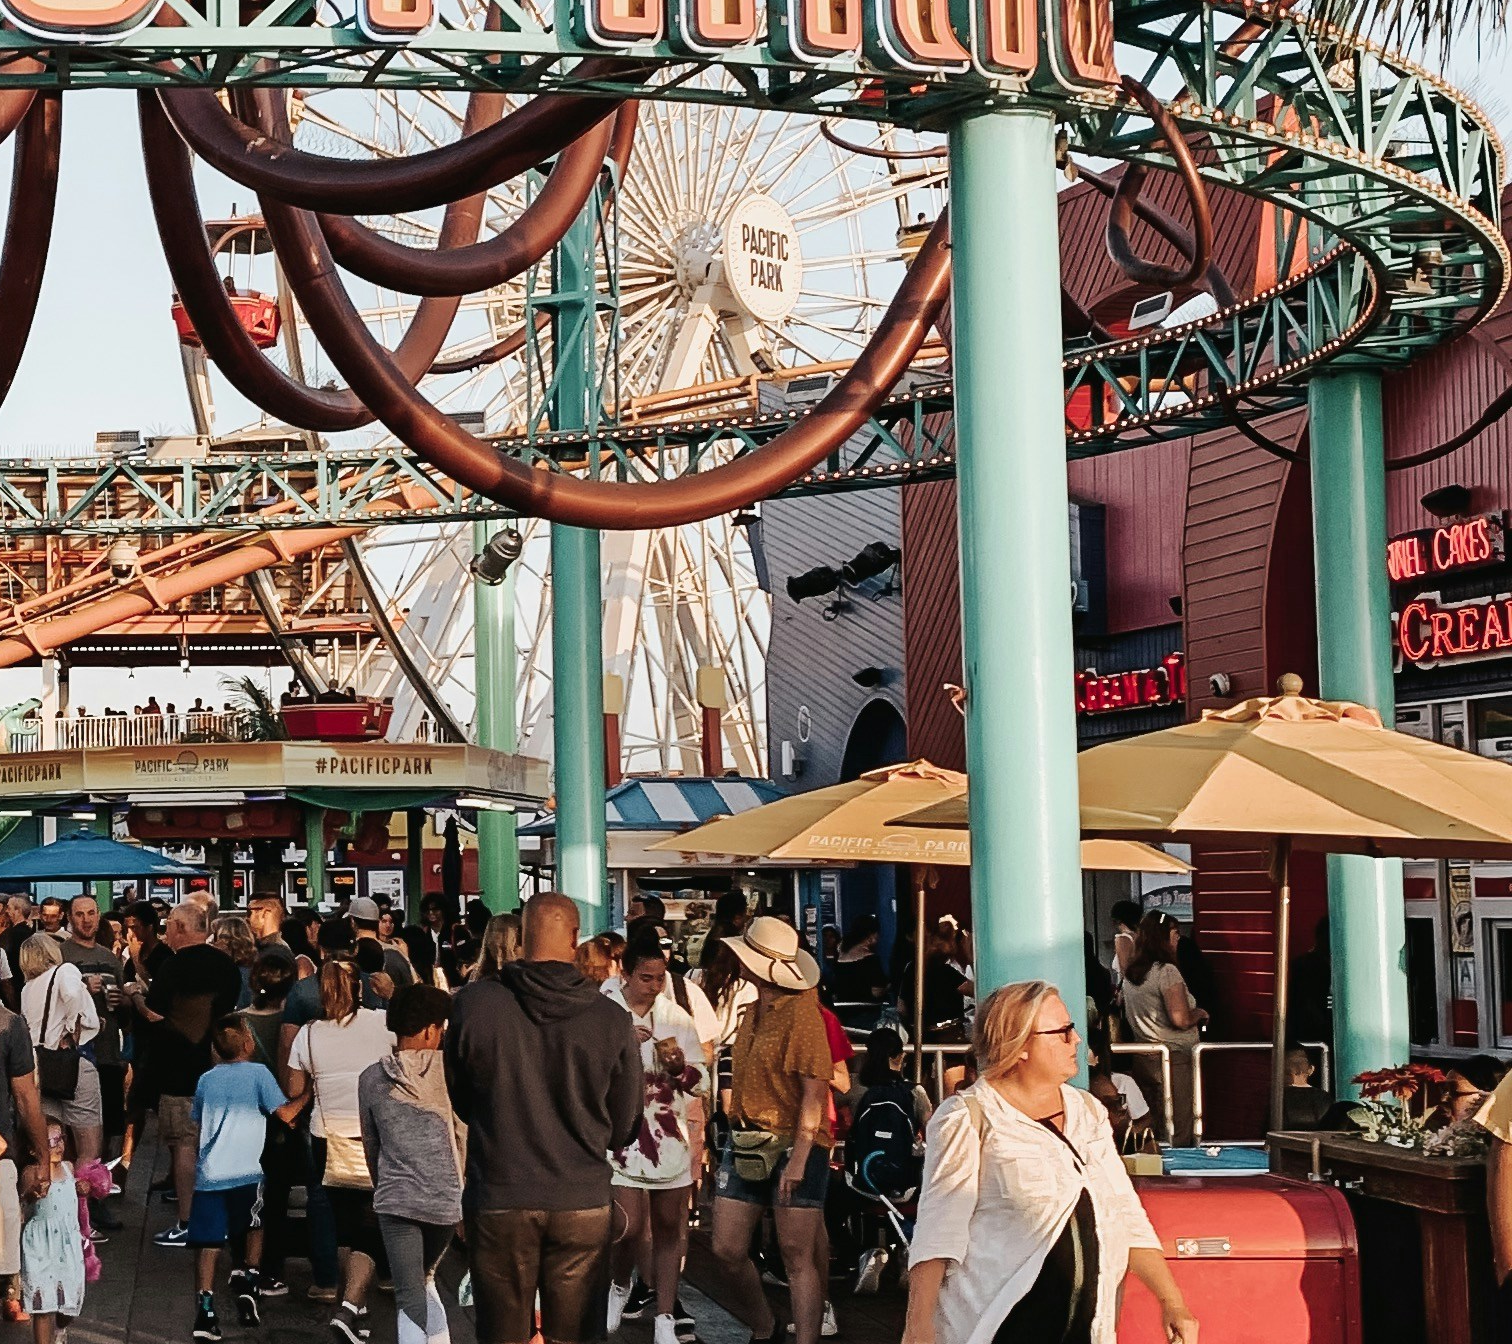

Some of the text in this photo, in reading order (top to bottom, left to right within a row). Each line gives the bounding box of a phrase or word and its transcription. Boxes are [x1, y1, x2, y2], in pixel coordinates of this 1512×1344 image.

[741, 223, 788, 262] PACIFIC
[750, 258, 784, 292] PARK
[1433, 518, 1490, 570] CAKES
[134, 757, 230, 773] PACIFIC PARK
[314, 757, 433, 776] #PACIFICPARK
[808, 835, 873, 848] PACIFIC
[1459, 959, 1472, 984] A
